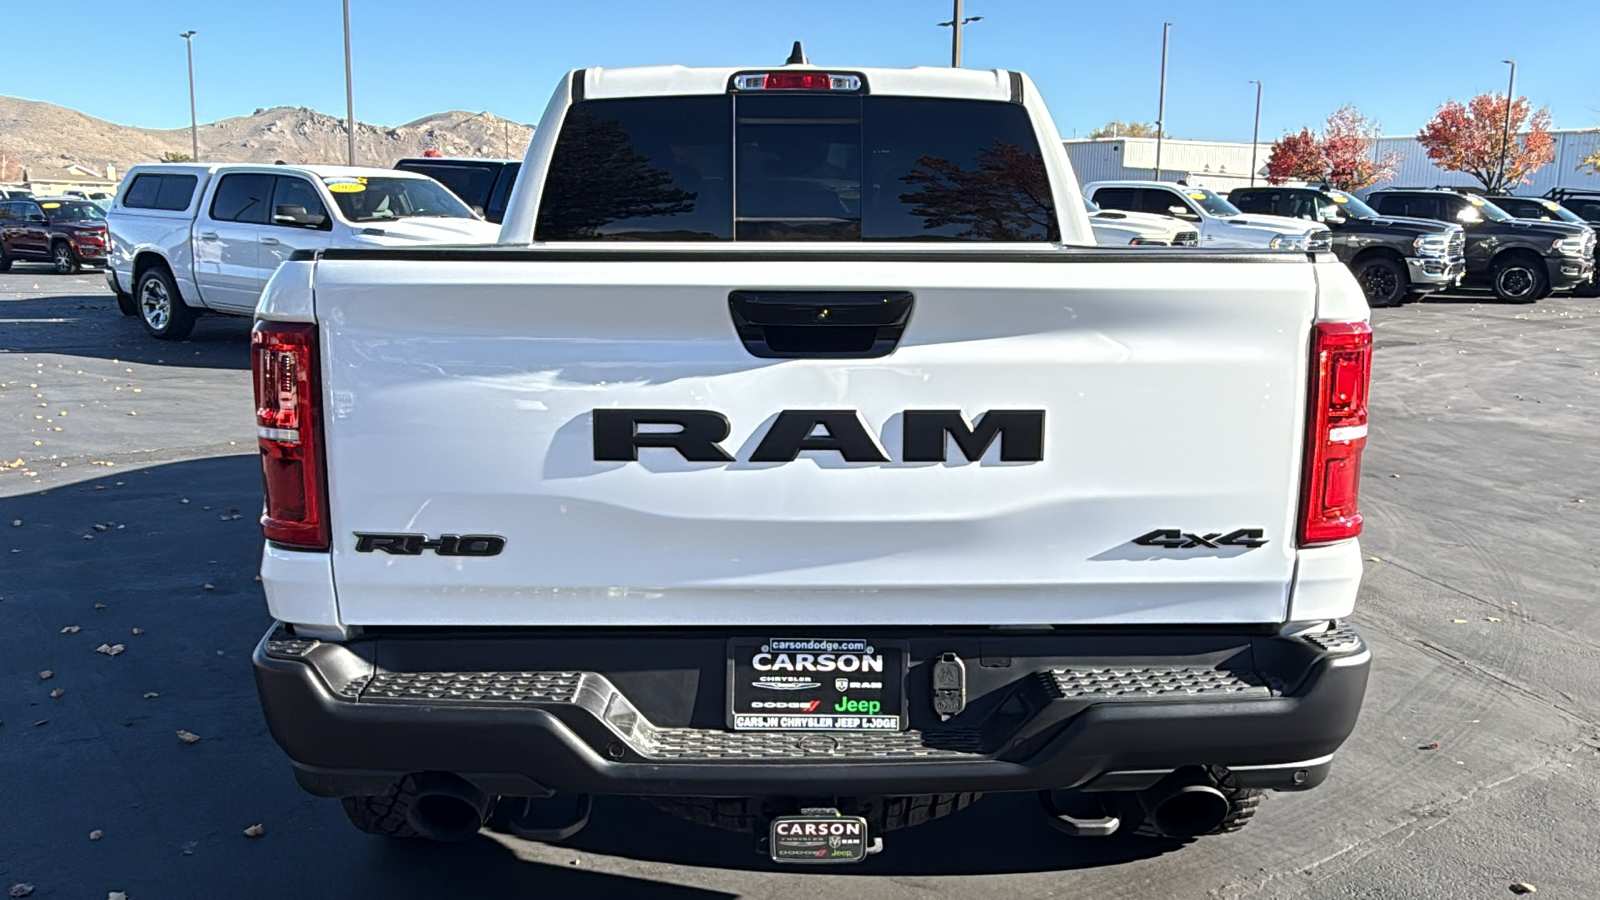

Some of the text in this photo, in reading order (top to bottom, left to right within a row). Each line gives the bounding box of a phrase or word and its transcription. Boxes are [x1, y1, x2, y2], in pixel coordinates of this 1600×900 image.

[593, 409, 1046, 462] RAM
[772, 640, 864, 651] carsondodge.com
[752, 653, 883, 672] CARSON
[834, 696, 881, 715] Jeep
[780, 717, 833, 727] CHRYSLER
[834, 718, 861, 727] JEEP
[777, 823, 860, 835] CARSON
